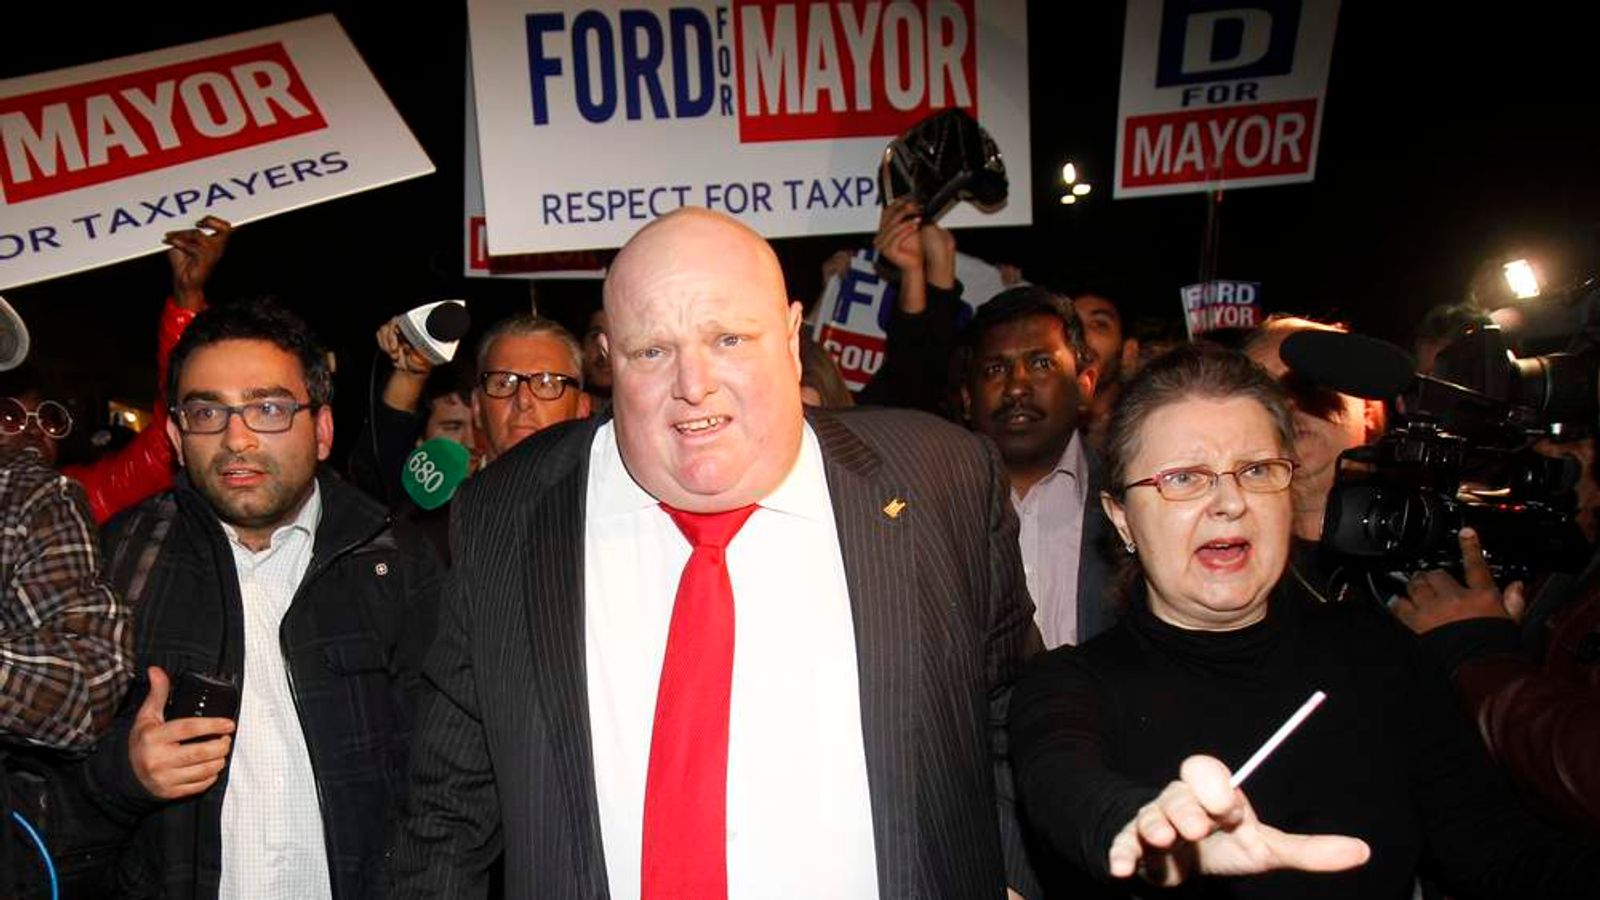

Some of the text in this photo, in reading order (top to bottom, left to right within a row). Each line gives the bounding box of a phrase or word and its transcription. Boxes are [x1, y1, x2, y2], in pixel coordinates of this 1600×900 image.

[525, 0, 973, 126] FORD FOR MAYOR
[1180, 7, 1273, 75] D
[0, 60, 312, 184] MAYOR
[1182, 81, 1259, 107] FOR
[1132, 112, 1306, 178] MAYOR
[72, 151, 350, 239] TAXPAYERS
[542, 176, 885, 225] RESPECT FOR TAXP
[409, 451, 444, 493] 680
